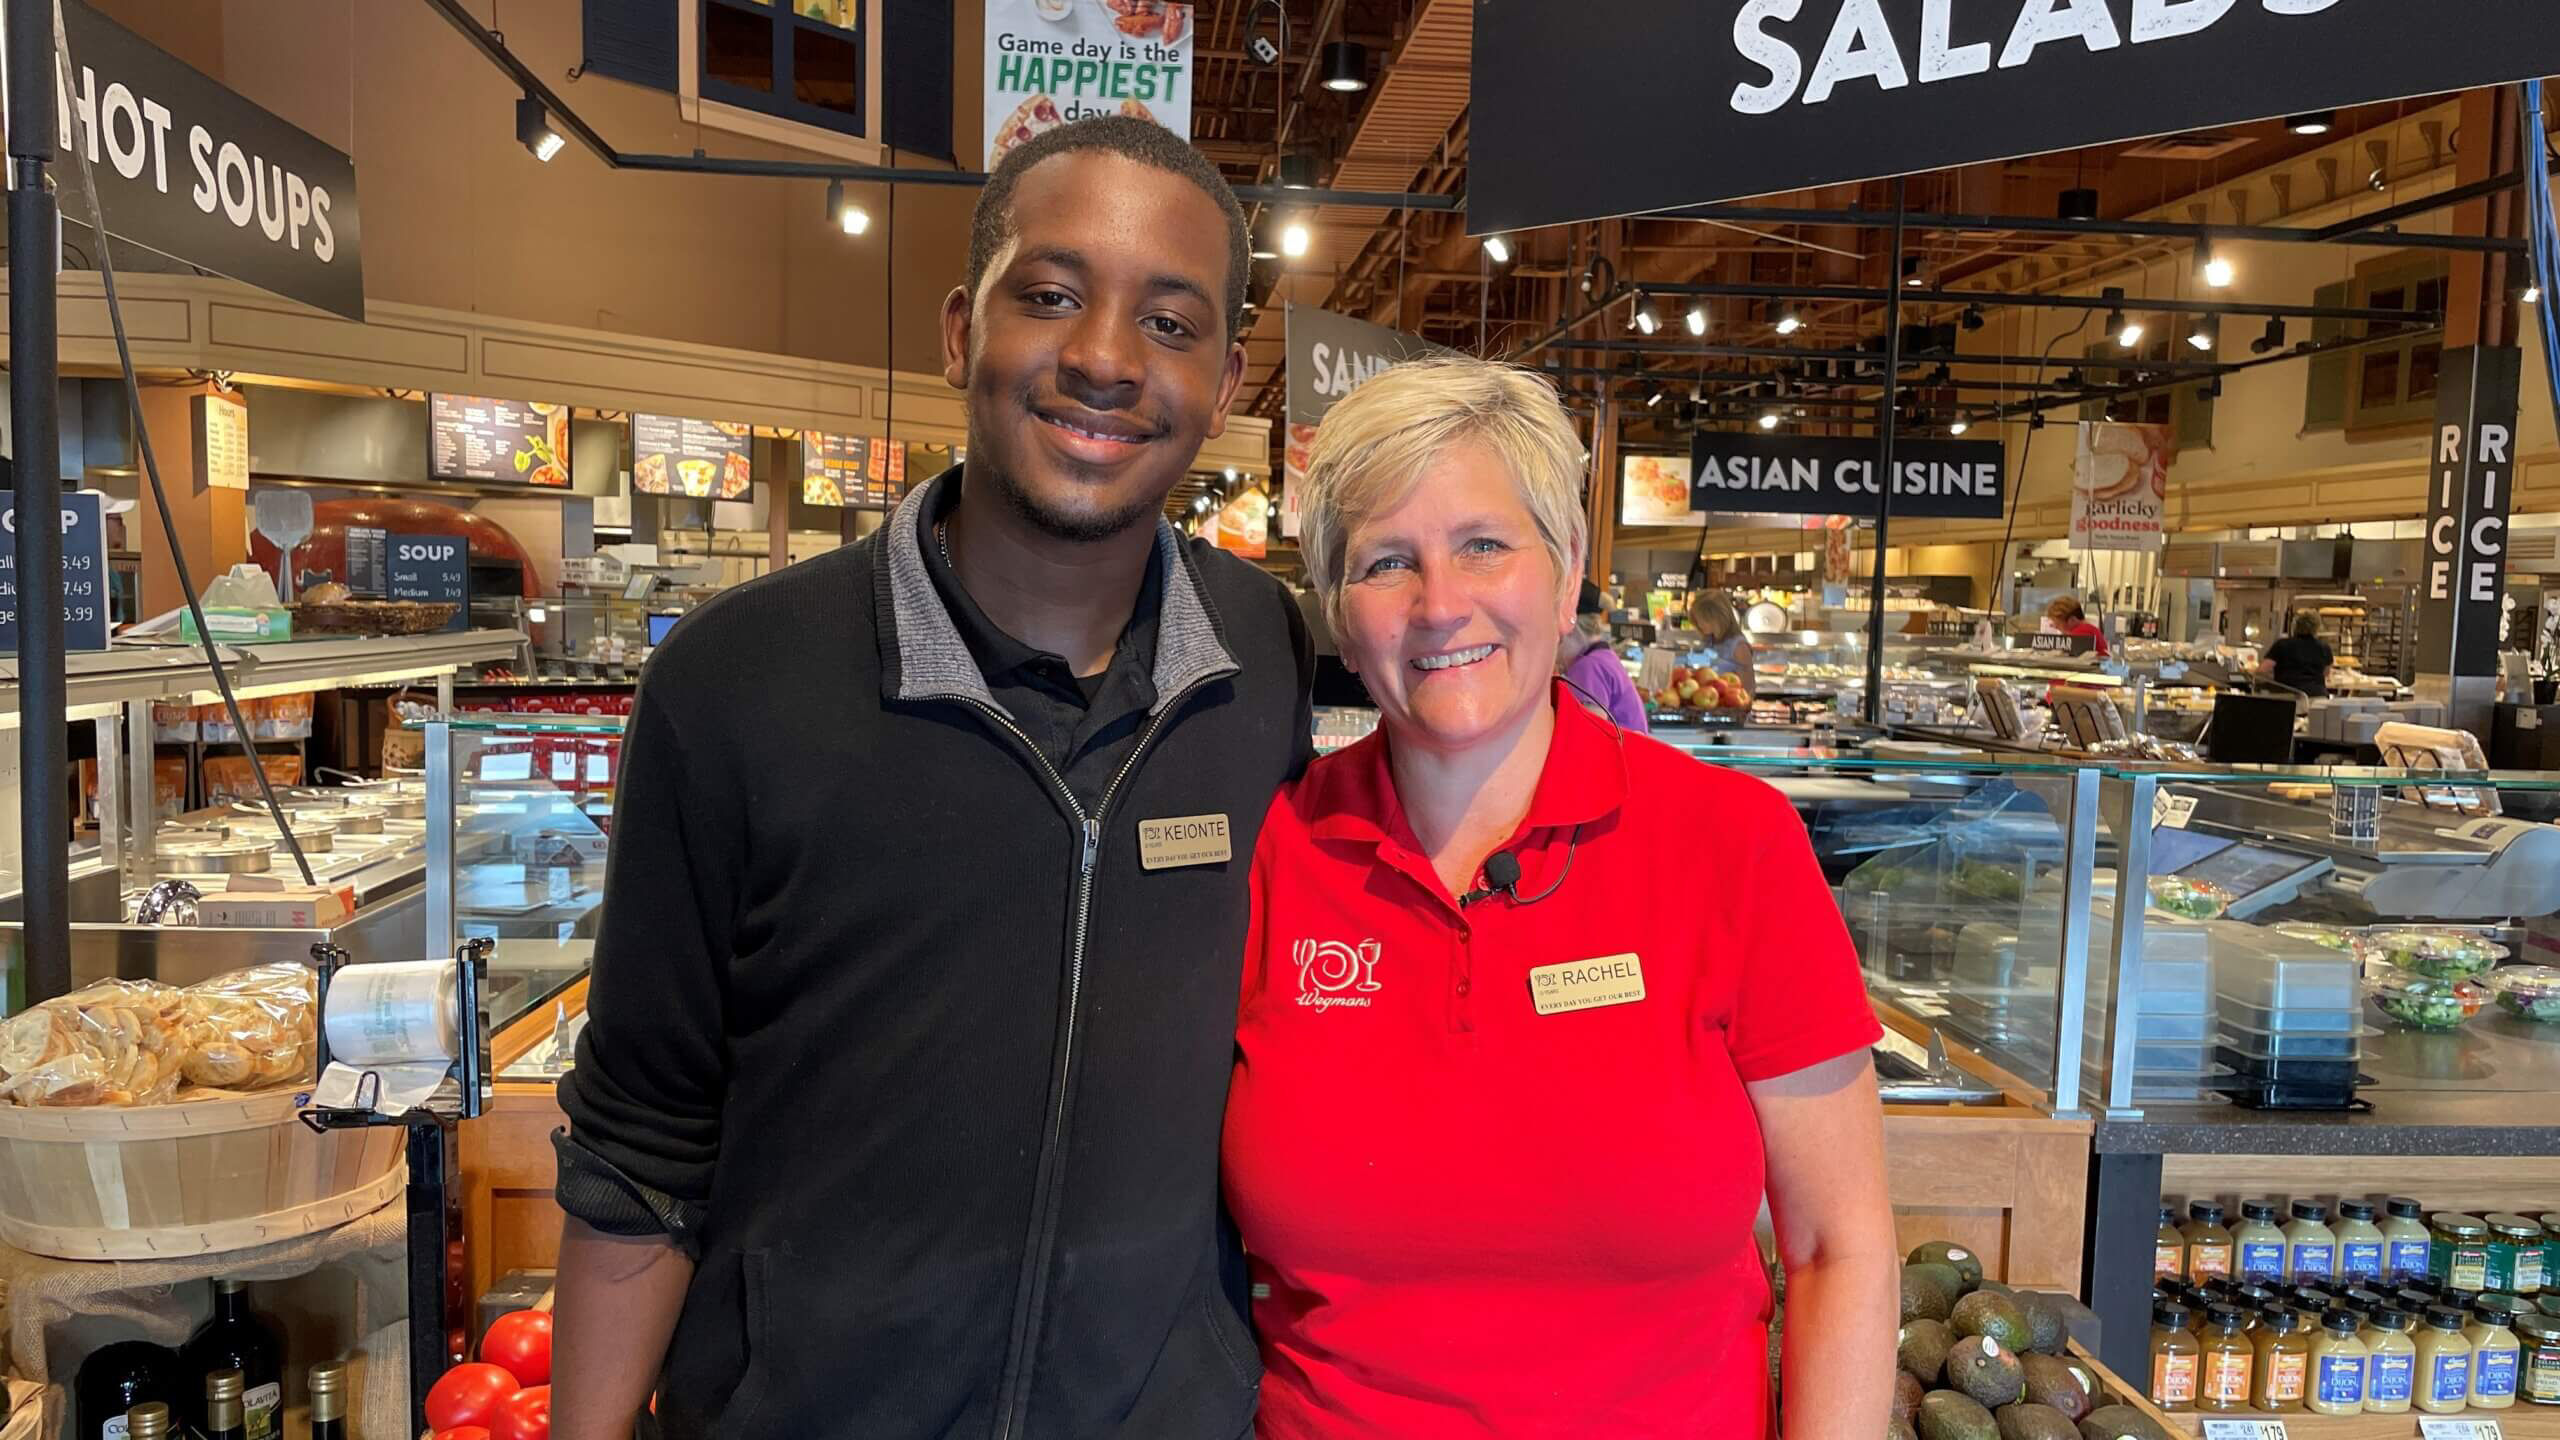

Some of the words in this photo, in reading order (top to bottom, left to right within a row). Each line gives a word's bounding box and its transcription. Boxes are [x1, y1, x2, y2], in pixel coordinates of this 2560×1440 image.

[998, 33, 1064, 54] Game
[1071, 37, 1112, 63] day
[1120, 41, 1136, 60] is
[1143, 43, 1180, 62] the
[1730, 0, 2342, 114] SALA
[998, 54, 1183, 103] HAPPIEST
[55, 51, 171, 193] HOT
[189, 124, 335, 263] SOUPS
[1697, 455, 1819, 492] ASIAN
[1834, 460, 1997, 496] CUISINE
[2430, 424, 2461, 600] RICE
[2470, 424, 2510, 601] RICE
[399, 544, 455, 561] SOUP
[2032, 634, 2054, 648] ASIAN
[1165, 821, 1225, 841] KEIONTE
[1562, 961, 1637, 987] RACHEL
[1295, 987, 1371, 1013] Wegmans
